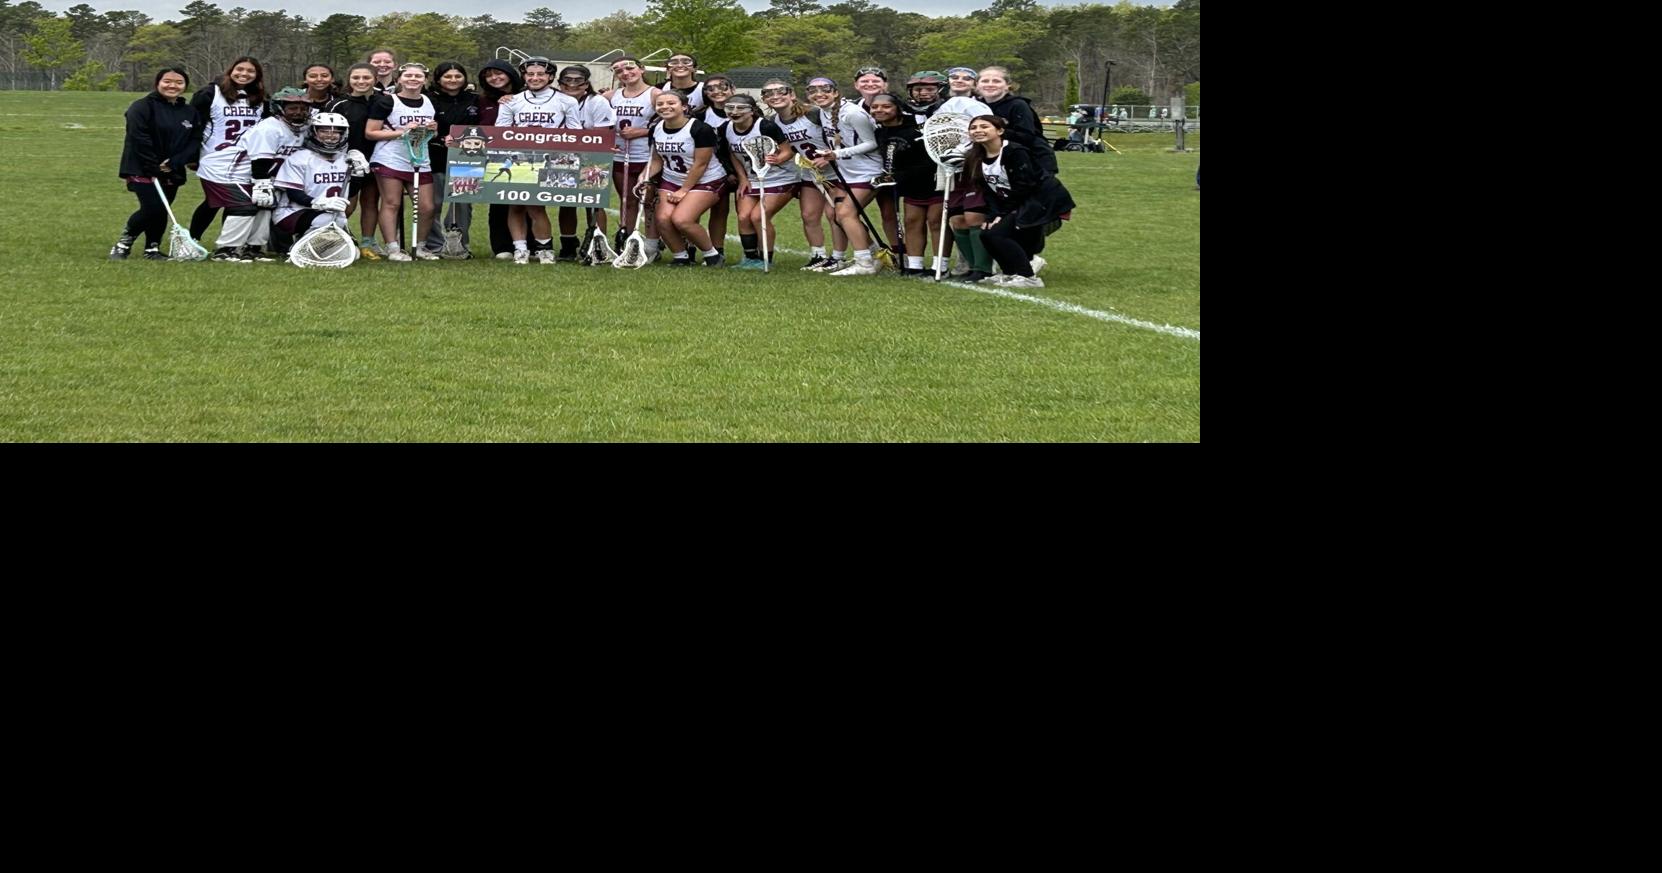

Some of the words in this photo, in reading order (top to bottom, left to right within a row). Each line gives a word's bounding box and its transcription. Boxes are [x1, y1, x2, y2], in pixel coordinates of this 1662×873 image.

[518, 112, 556, 124] CREEK
[502, 130, 577, 144] Congrats
[581, 134, 603, 144] on
[662, 155, 688, 174] 13
[313, 171, 347, 185] CREE
[496, 190, 530, 201] 100
[536, 191, 601, 204] Goals!
